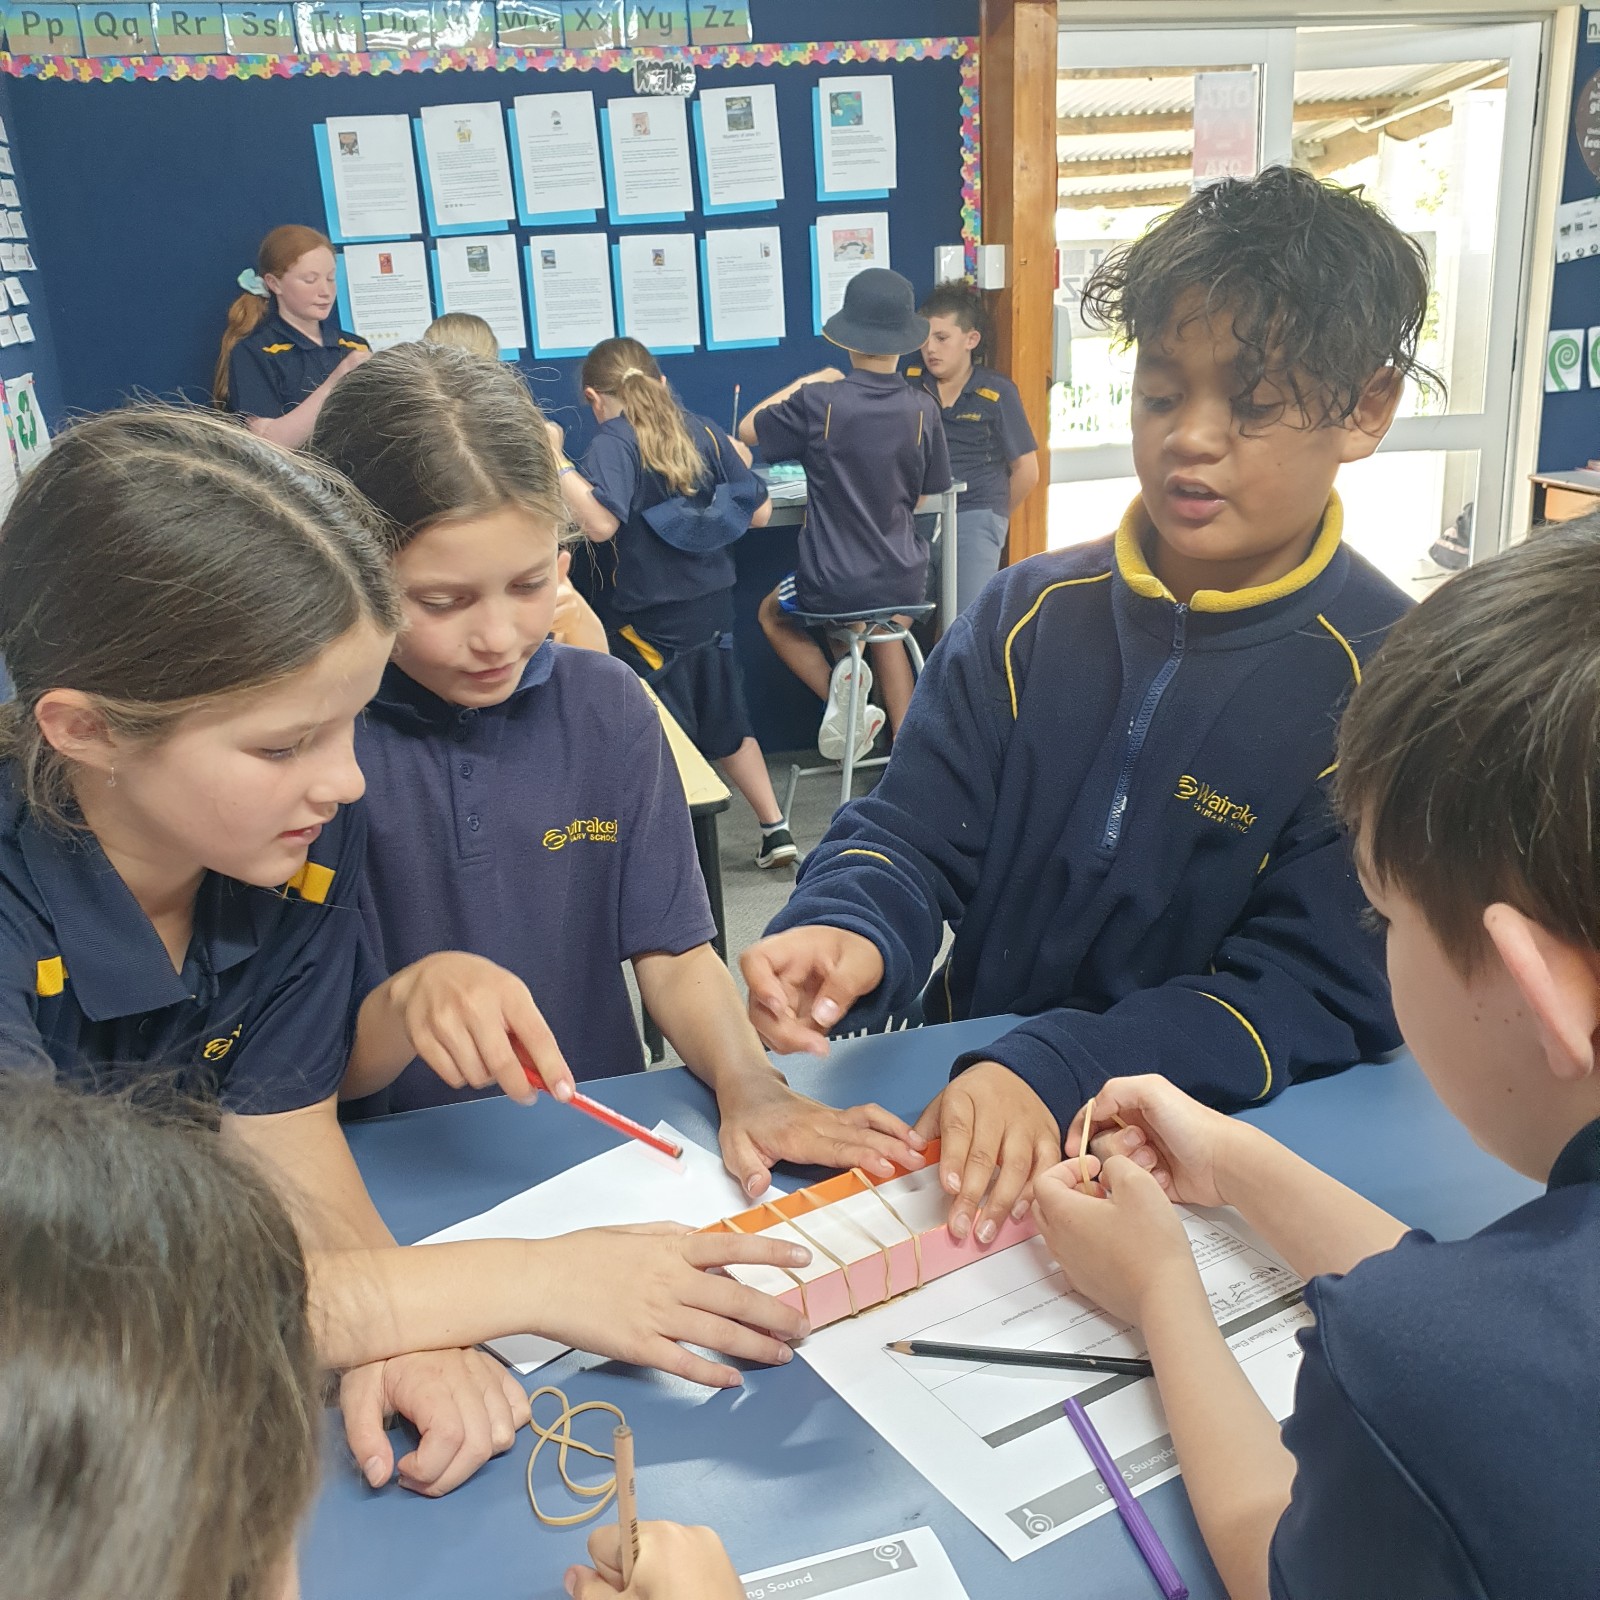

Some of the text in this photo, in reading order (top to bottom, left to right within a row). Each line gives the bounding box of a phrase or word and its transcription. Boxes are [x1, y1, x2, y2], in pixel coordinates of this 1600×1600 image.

[21, 11, 63, 44] Pp
[94, 11, 144, 44] Qq
[171, 11, 207, 36] Rr
[242, 11, 278, 37] Ss
[574, 7, 612, 32] Xx
[638, 7, 674, 36] Yy
[704, 4, 736, 29] Zz
[1129, 1446, 1176, 1473] xploring
[767, 1573, 813, 1593] Sound
